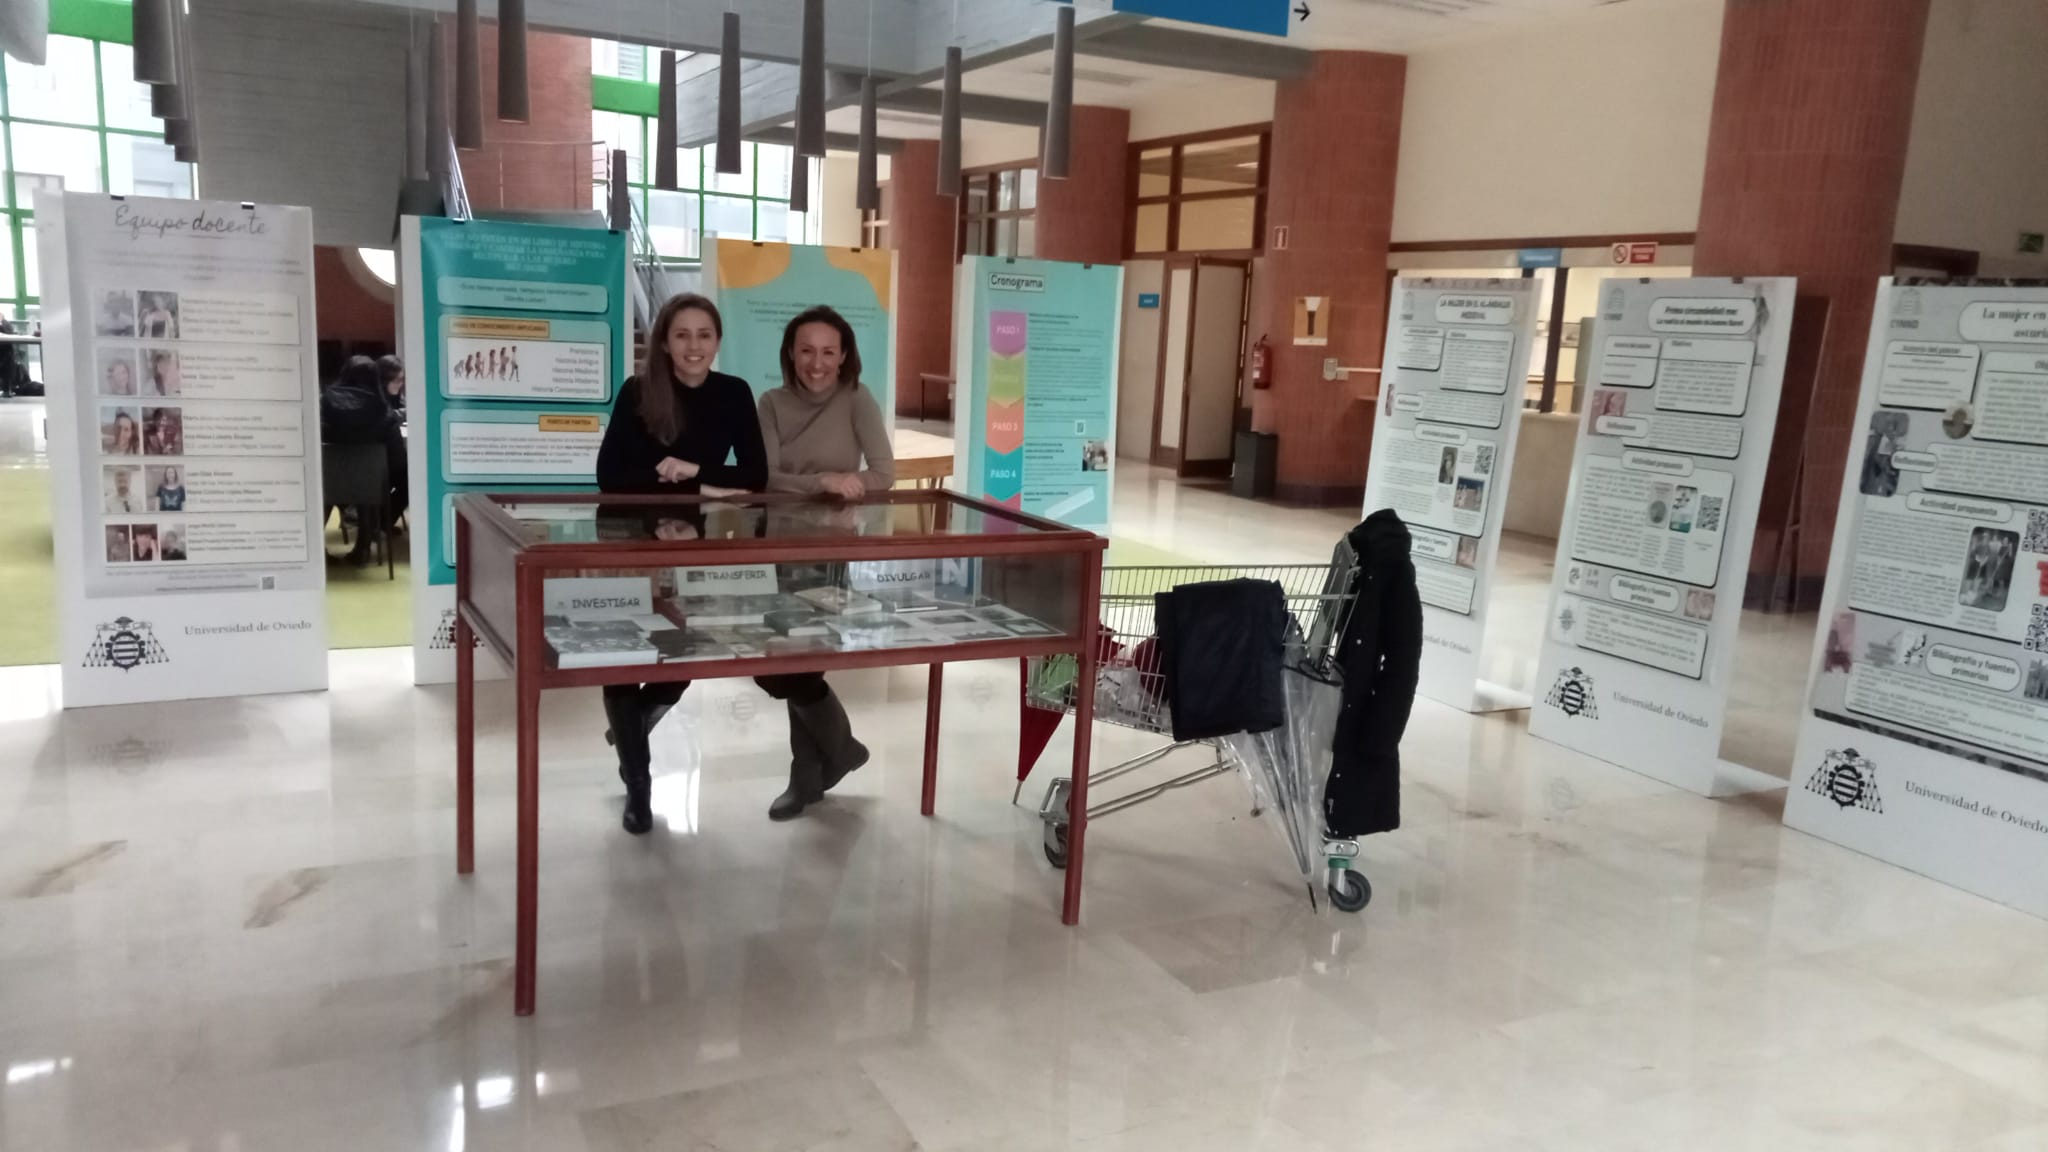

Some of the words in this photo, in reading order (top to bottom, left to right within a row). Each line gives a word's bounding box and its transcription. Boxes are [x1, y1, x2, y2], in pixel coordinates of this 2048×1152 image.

[114, 204, 188, 239] Equipo
[191, 206, 267, 234] docente
[990, 274, 1044, 291] Cronograma
[1983, 307, 1995, 319] La
[1998, 309, 2030, 322] mujer
[2032, 310, 2046, 320] en
[996, 325, 1016, 335] PASO
[992, 421, 1011, 432] PASO
[990, 469, 1010, 479] PASO
[707, 570, 768, 581] TRANSFERIR
[877, 572, 931, 583] DIVULGAR
[572, 598, 641, 609] INVESTIGAR
[184, 624, 254, 636] Universidad
[256, 624, 270, 633] de
[272, 620, 312, 632] Oviedo
[1613, 691, 1663, 716] Universidad
[1664, 707, 1676, 719] de
[1676, 710, 1710, 729] Oviedo
[1904, 780, 1979, 813] Universidad
[1981, 805, 1998, 819] de
[2000, 809, 2048, 835] Oviedo
